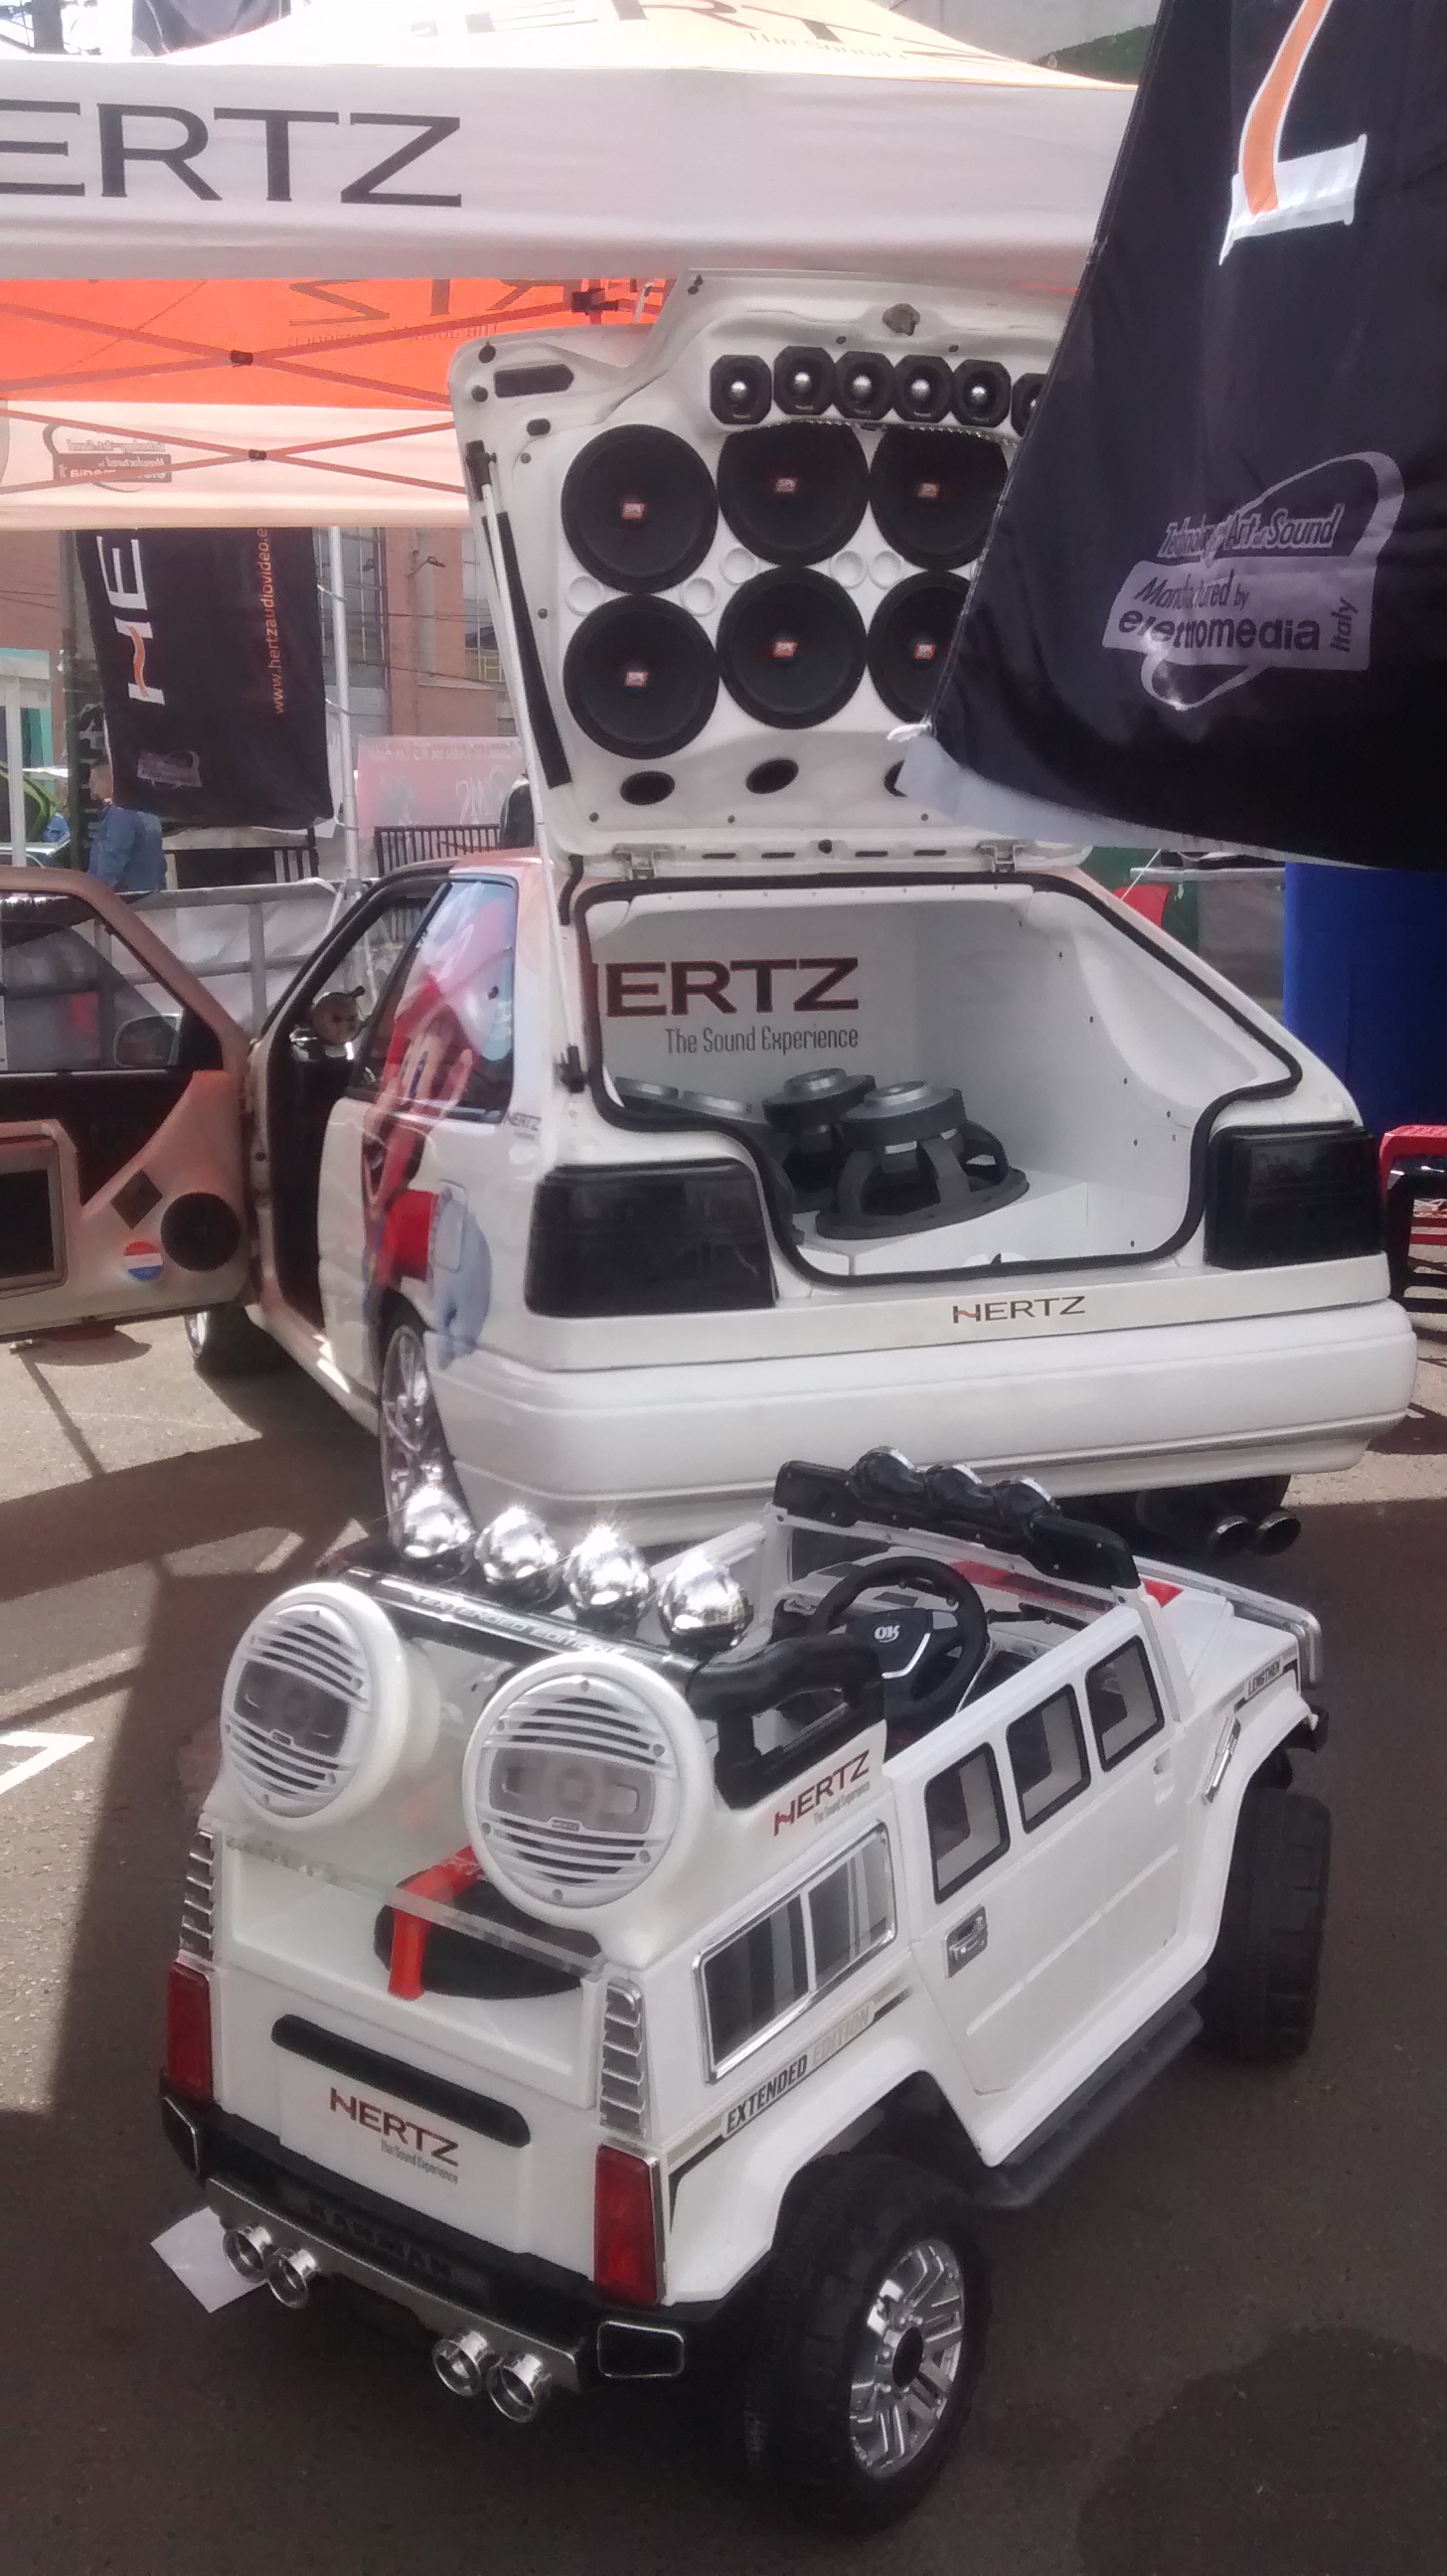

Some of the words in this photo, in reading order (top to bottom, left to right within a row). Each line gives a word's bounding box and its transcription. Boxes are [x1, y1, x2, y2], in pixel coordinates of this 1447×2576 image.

[1267, 504, 1345, 547] Sound
[1331, 597, 1358, 652] Italy
[666, 1027, 698, 1055] The
[703, 1025, 756, 1053] Sound
[761, 1023, 860, 1056] Experience
[952, 1295, 1086, 1325] HERTZ
[773, 1748, 870, 1838] HERTZ
[726, 2048, 808, 2135] EXTENDED
[330, 2086, 459, 2168] HERTZ
